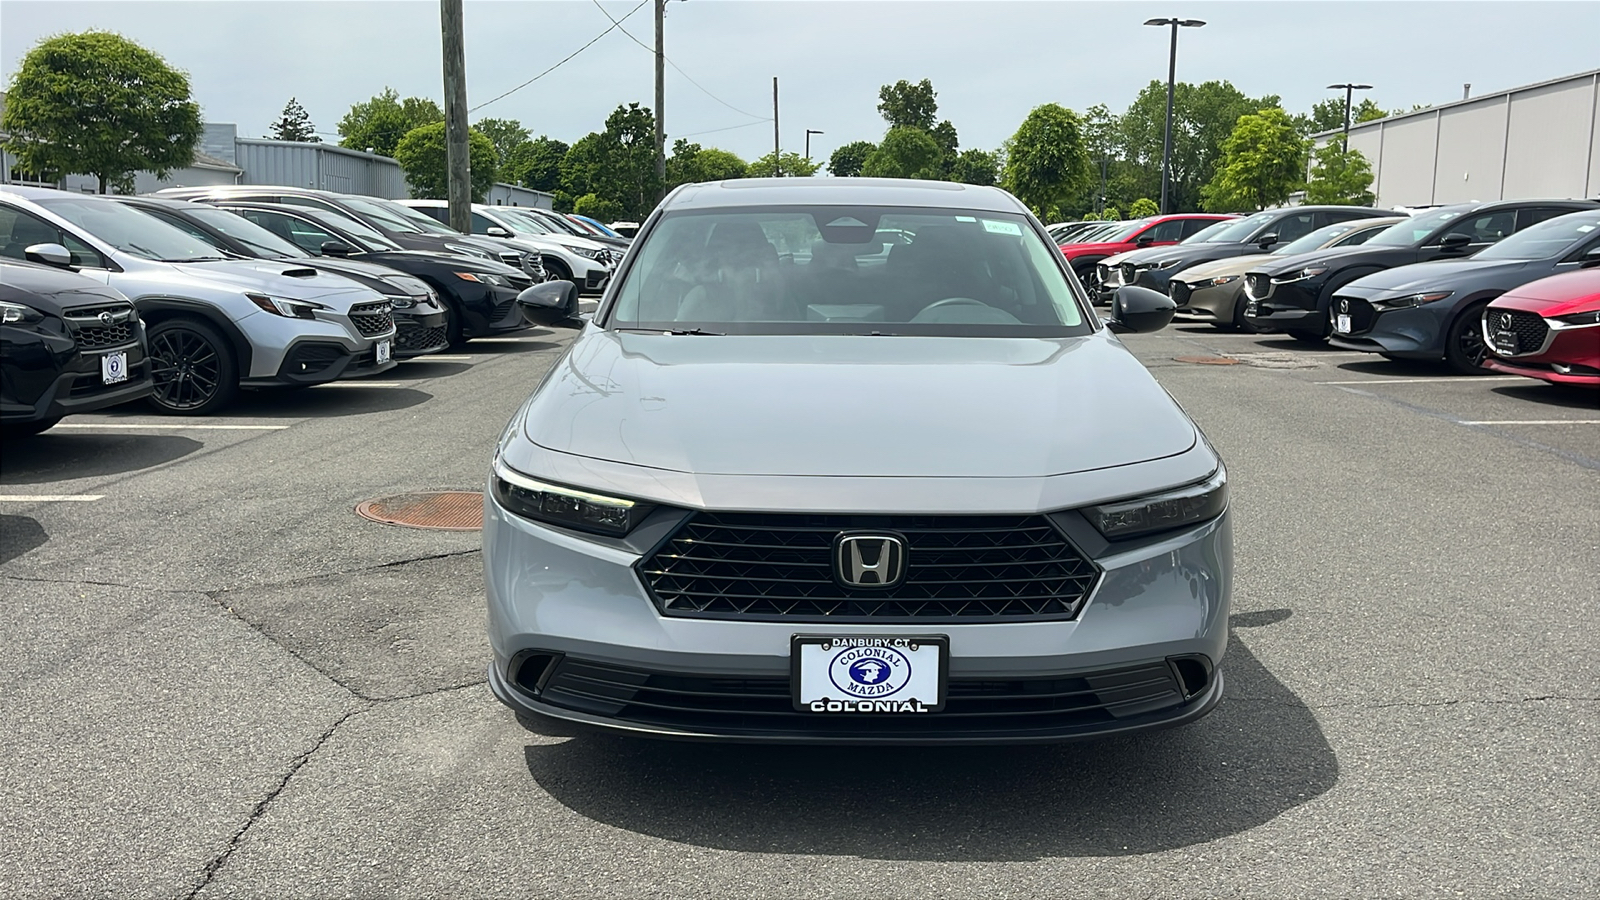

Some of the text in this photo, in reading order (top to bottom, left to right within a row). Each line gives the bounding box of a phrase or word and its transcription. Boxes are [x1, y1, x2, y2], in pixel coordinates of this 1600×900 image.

[894, 638, 910, 647] CT
[840, 648, 901, 668] COLONIAL
[847, 681, 894, 695] MAZDA
[810, 701, 928, 713] COLONIAL
